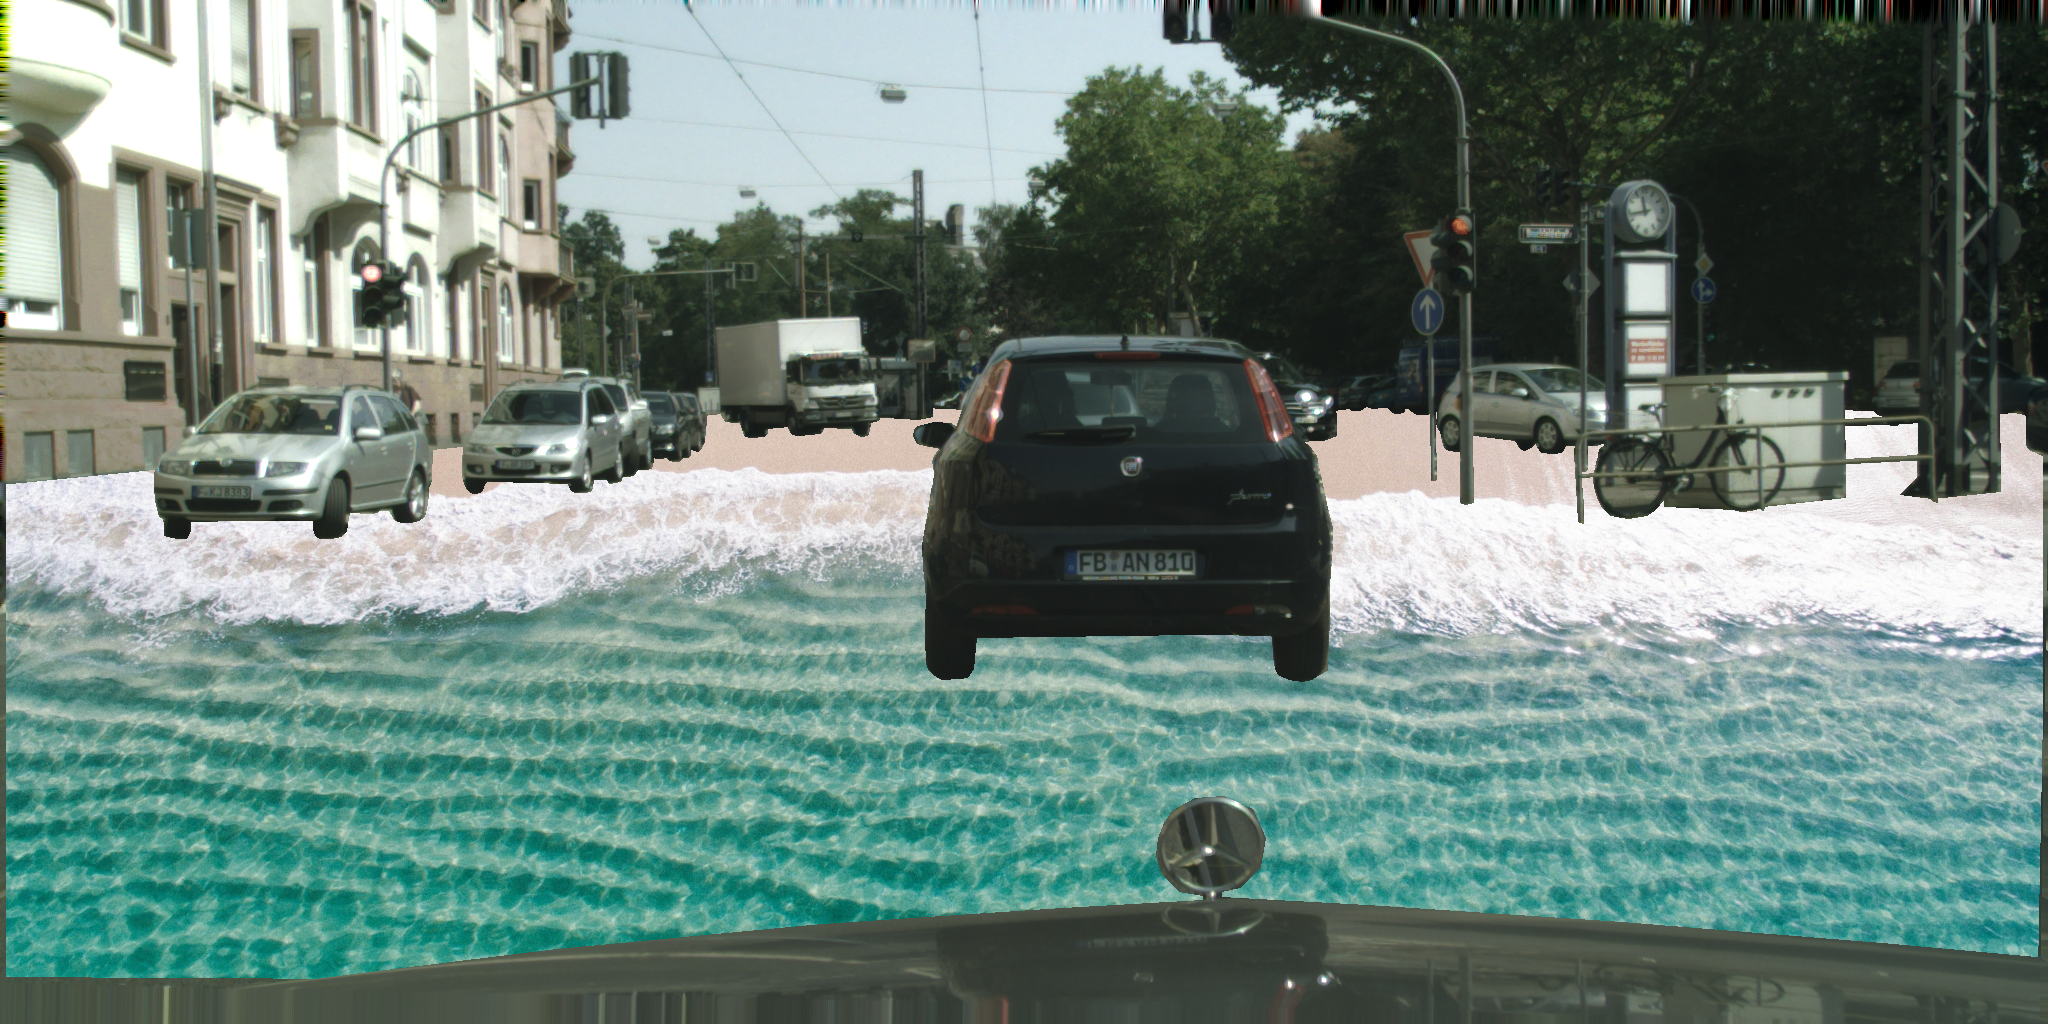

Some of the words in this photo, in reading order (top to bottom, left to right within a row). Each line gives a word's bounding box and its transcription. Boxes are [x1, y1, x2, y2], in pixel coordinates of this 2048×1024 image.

[1079, 552, 1107, 572] FB
[1122, 552, 1150, 572] AN
[1154, 552, 1194, 572] 810
